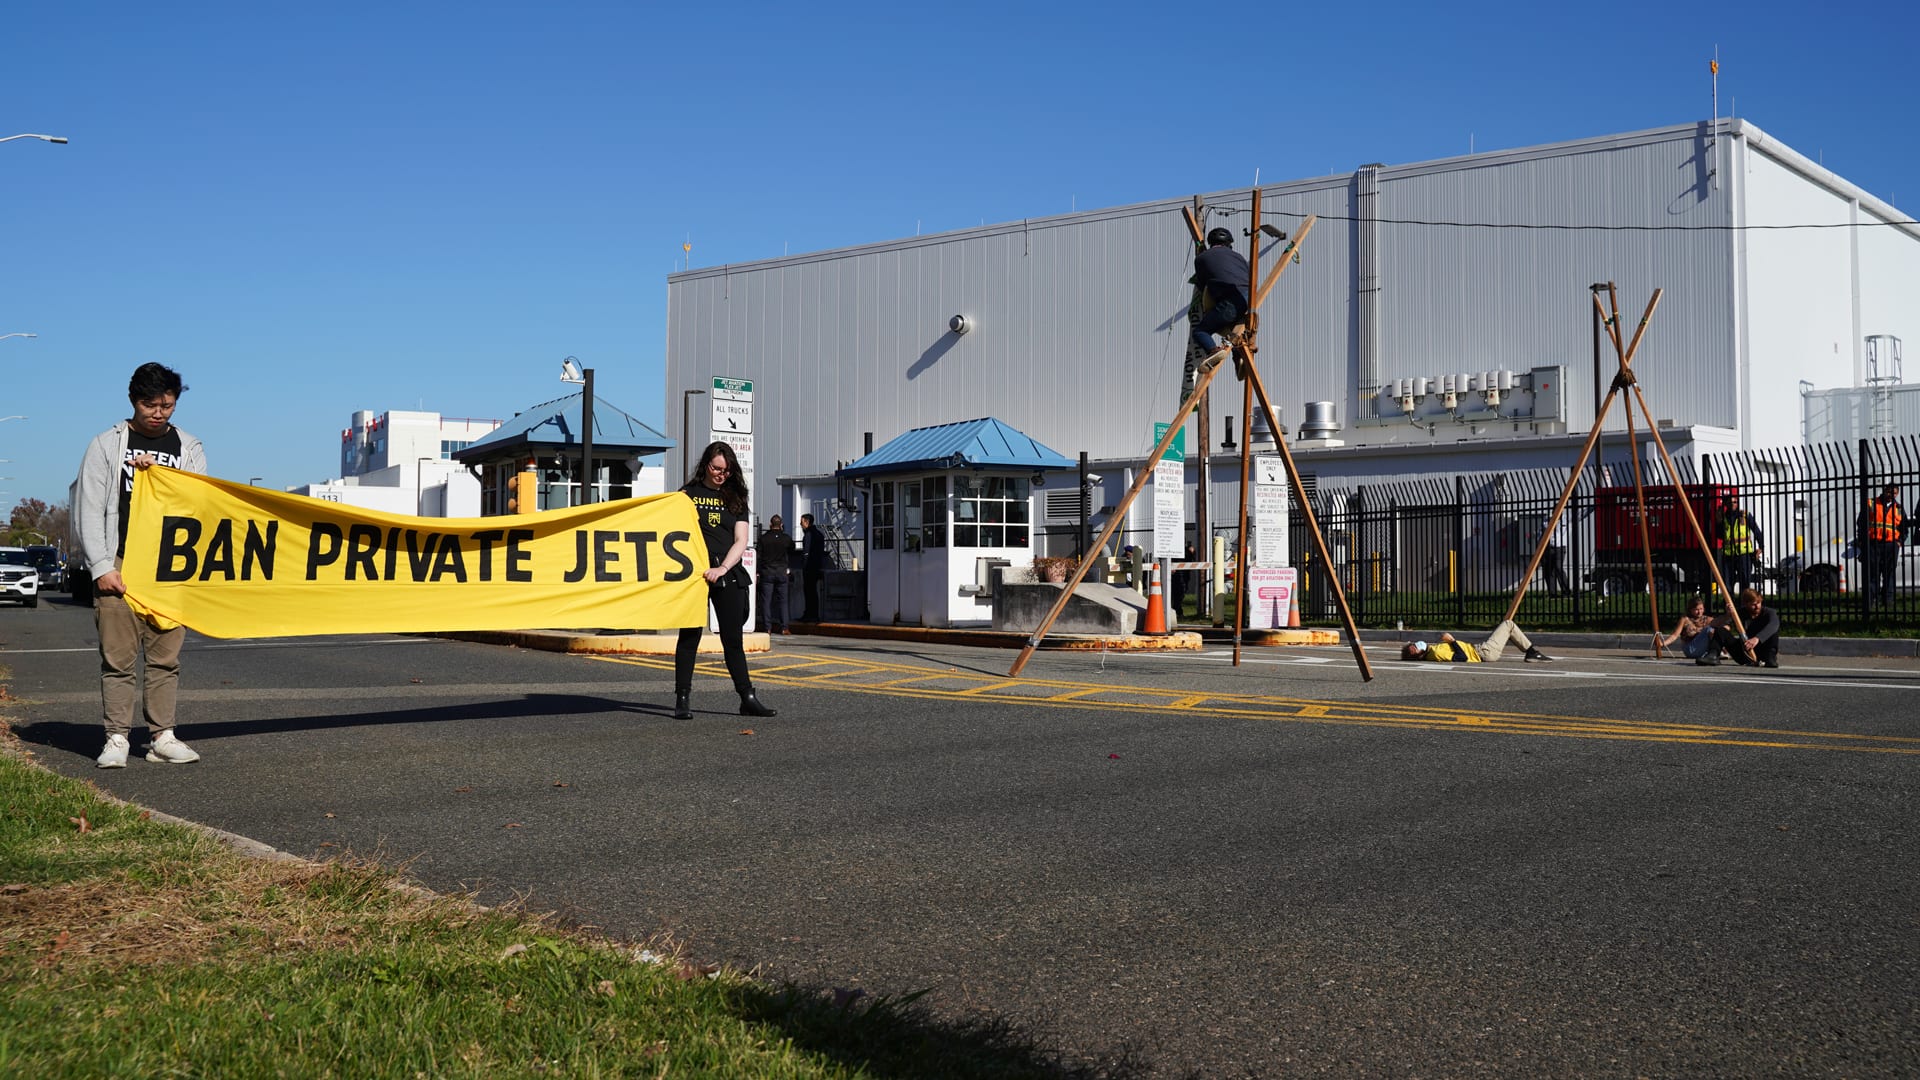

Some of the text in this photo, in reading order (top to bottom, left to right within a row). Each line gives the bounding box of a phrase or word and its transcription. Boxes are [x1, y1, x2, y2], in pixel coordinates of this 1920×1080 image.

[716, 405, 749, 415] ALL TRUCKS
[124, 448, 181, 470] GREEN
[322, 494, 338, 503] 113
[155, 515, 694, 583] BAN PRIVATE JETS
